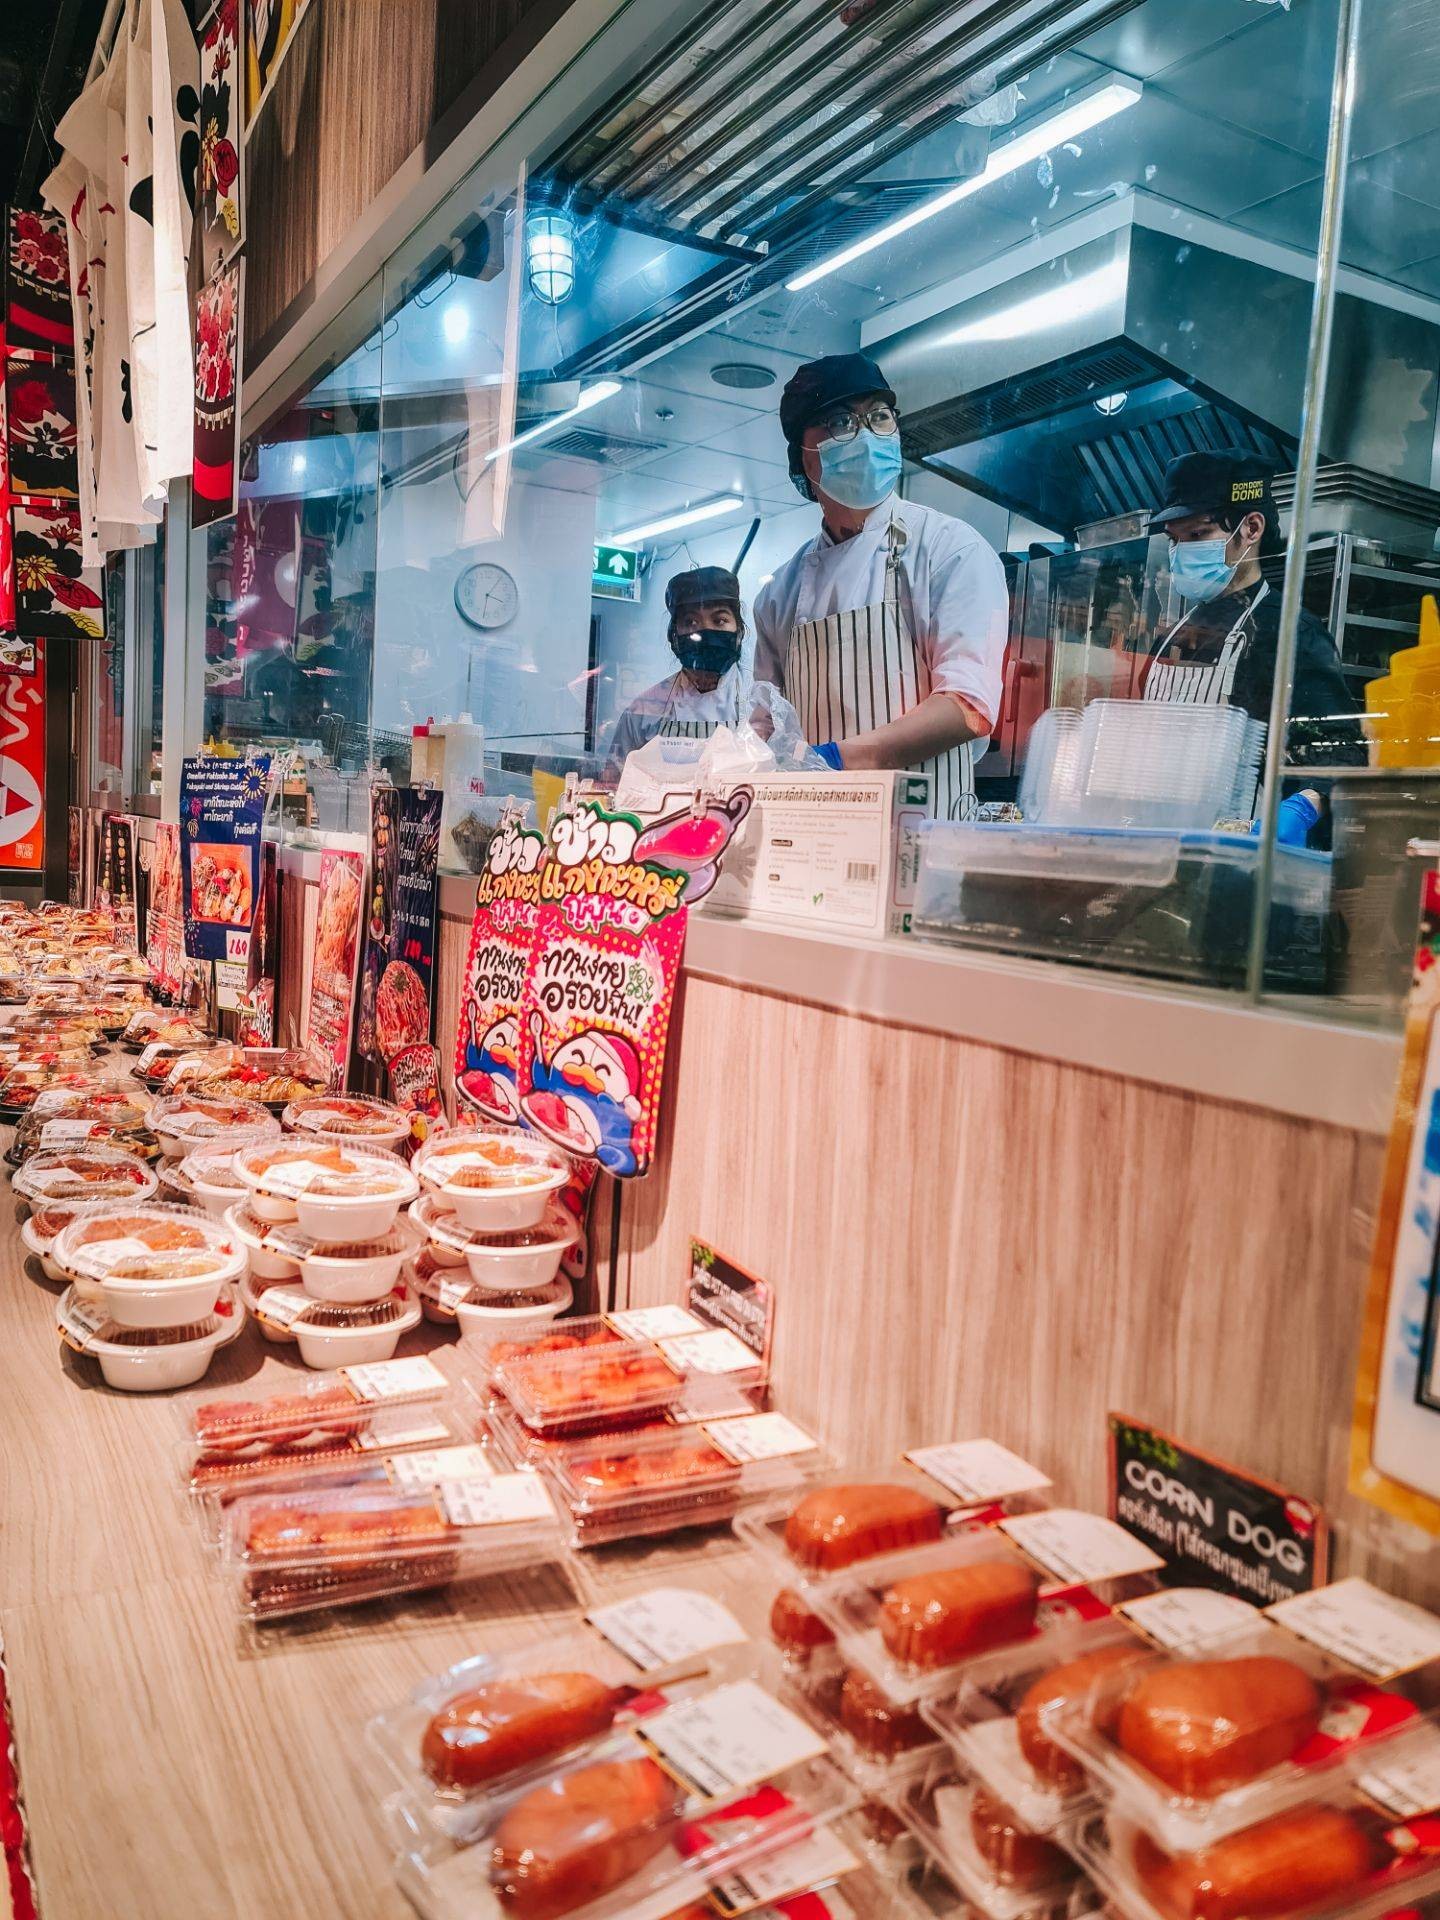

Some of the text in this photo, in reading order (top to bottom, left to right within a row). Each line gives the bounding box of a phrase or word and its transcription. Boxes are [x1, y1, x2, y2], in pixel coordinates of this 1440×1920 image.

[1232, 483, 1248, 491] DON
[1232, 488, 1263, 501] DONKI
[552, 807, 638, 866] ข้าว
[542, 858, 686, 916] แกงกะหรี่
[229, 939, 248, 956] 169
[542, 948, 625, 988] ทานง่าย
[1124, 1460, 1214, 1527] CORN
[1227, 1510, 1306, 1574] DOG
